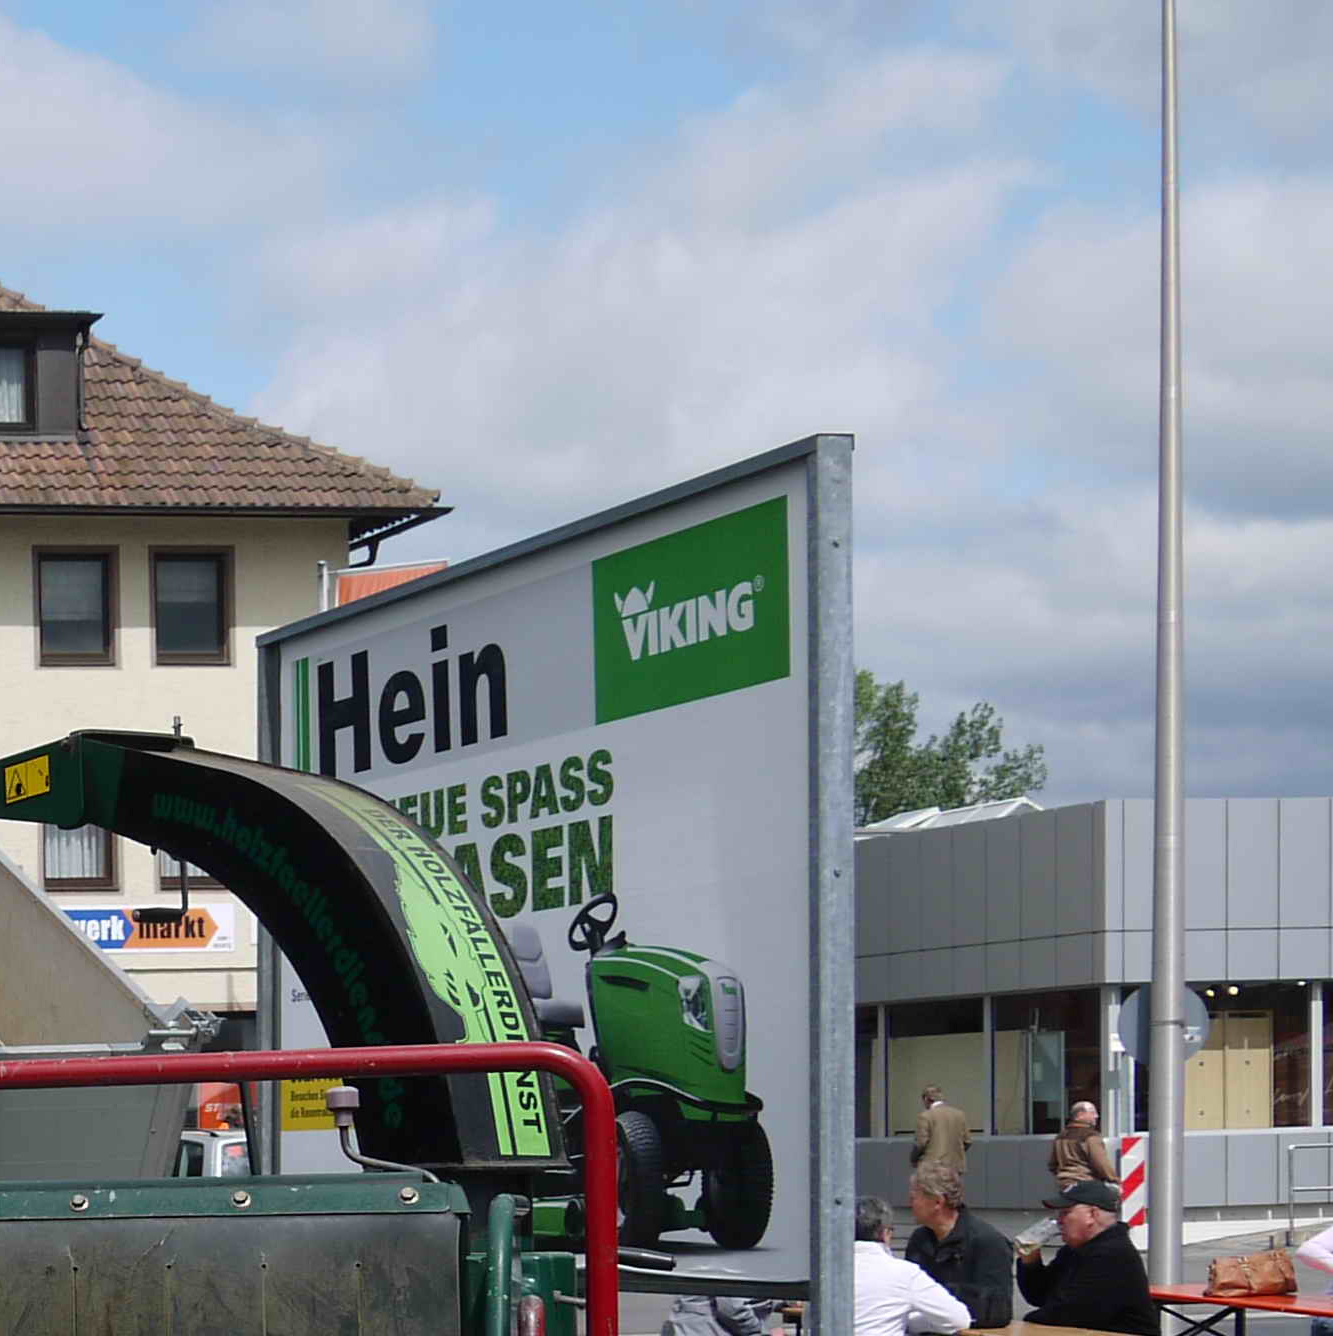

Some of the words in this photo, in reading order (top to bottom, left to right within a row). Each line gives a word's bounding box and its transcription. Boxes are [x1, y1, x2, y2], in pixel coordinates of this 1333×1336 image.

[622, 581, 754, 660] VIKING
[317, 624, 508, 778] Hein
[480, 749, 614, 829] SPASS
[454, 815, 613, 918] ASEN
[139, 916, 206, 939] markt
[360, 807, 413, 842] DER
[406, 841, 544, 1136] HOLZFÄLLERDINST
